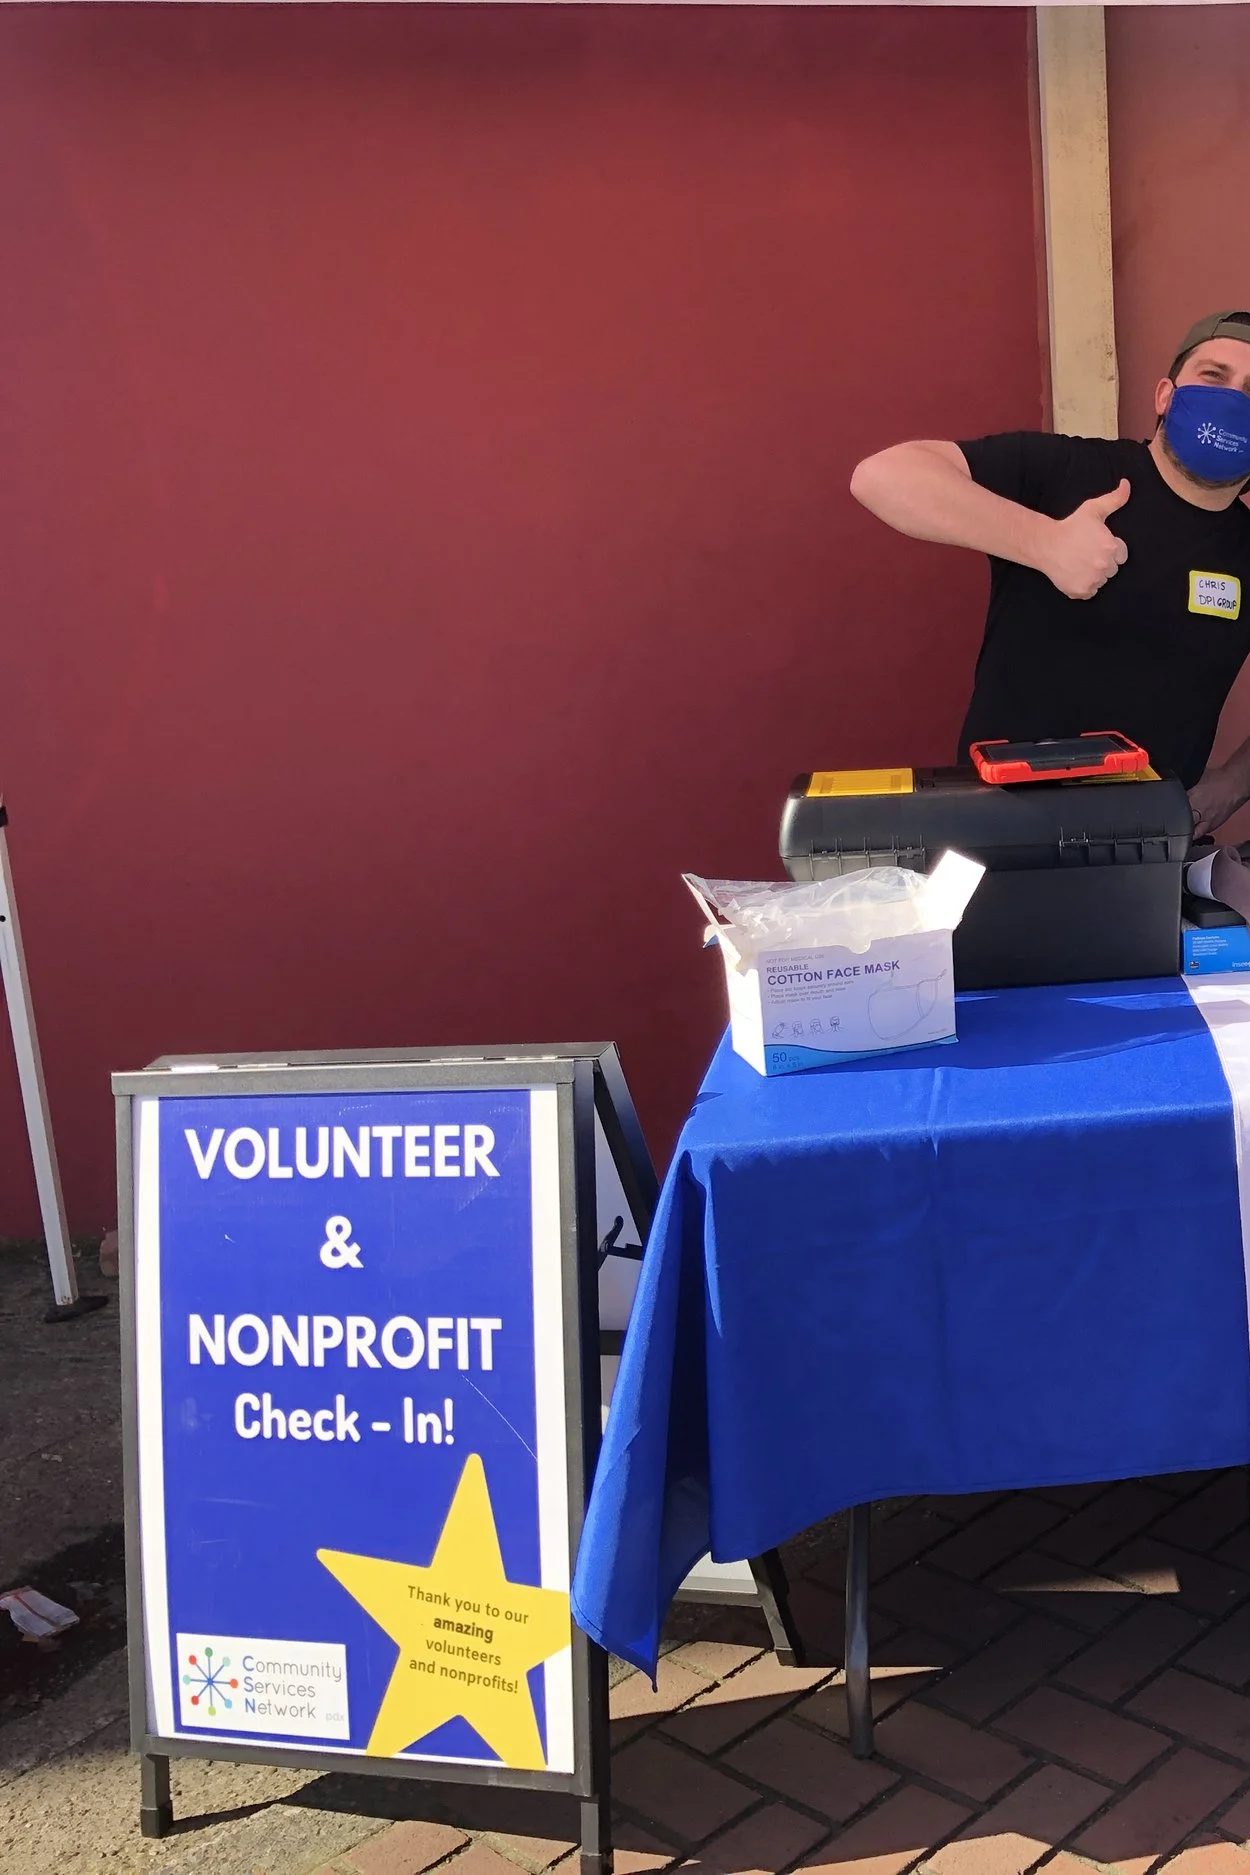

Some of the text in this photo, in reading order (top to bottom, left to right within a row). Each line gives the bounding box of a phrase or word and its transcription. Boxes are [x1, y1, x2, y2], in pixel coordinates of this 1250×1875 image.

[1214, 441, 1238, 453] Network
[1198, 579, 1226, 591] CHRIS
[1217, 597, 1238, 611] GROUP
[766, 963, 809, 974] REUSABLE
[767, 960, 901, 986] COTTON FACE MASK
[772, 1051, 787, 1063] 50
[184, 1124, 501, 1180] VOLUNTEER
[319, 1215, 365, 1269] &
[188, 1313, 503, 1371] NONPROFIT
[234, 1392, 361, 1443] Check
[403, 1397, 455, 1446] In!
[407, 1585, 530, 1625] Thank you to our
[433, 1616, 495, 1644] amazing
[425, 1637, 502, 1666] volunteers
[242, 1655, 342, 1683] Community
[409, 1657, 519, 1694] and nonprofits!
[243, 1676, 316, 1698] Services
[245, 1698, 345, 1723] Network pdx
